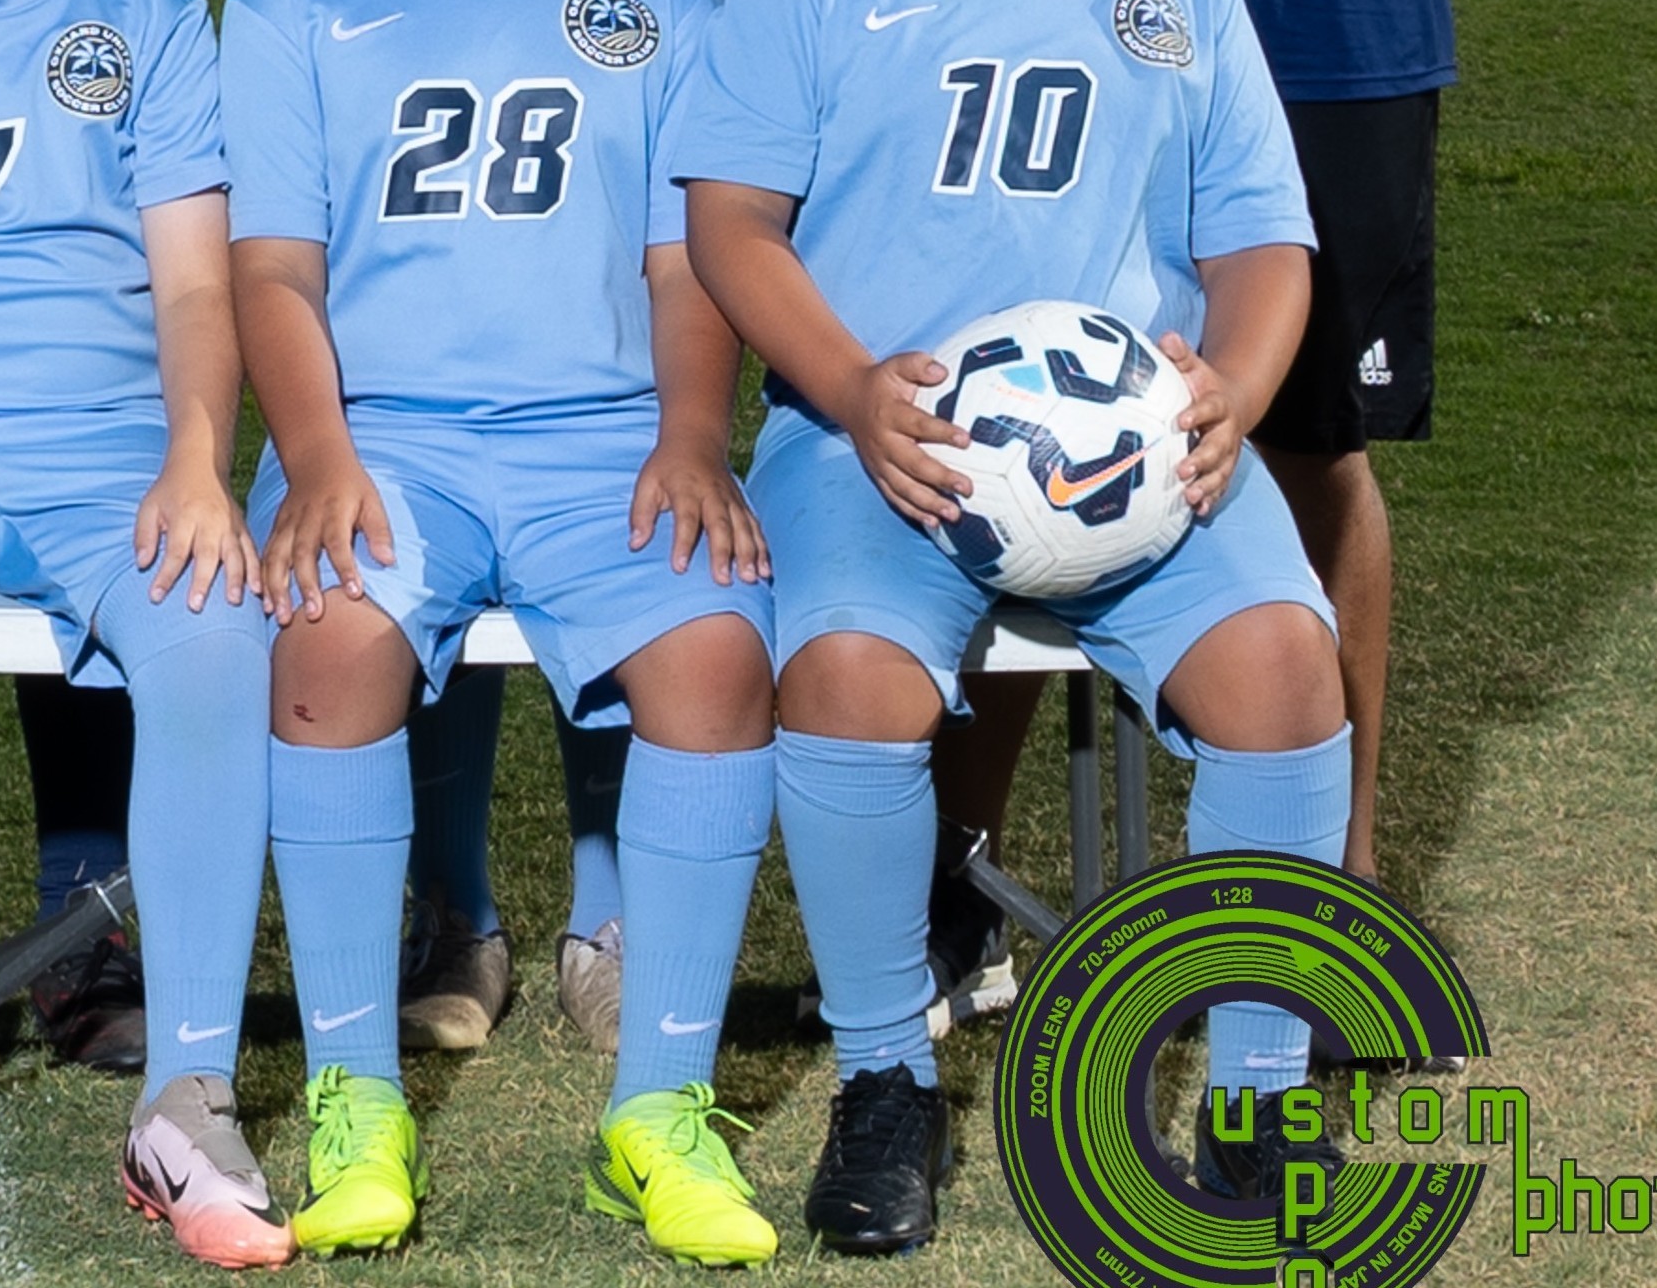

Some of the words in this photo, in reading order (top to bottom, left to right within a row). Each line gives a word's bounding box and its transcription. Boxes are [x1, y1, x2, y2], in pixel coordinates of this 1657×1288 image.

[572, 29, 624, 65] SOCCER
[626, 39, 656, 62] CLUB
[51, 79, 101, 112] SOCCER
[931, 57, 1098, 199] 10
[377, 77, 585, 224] 28
